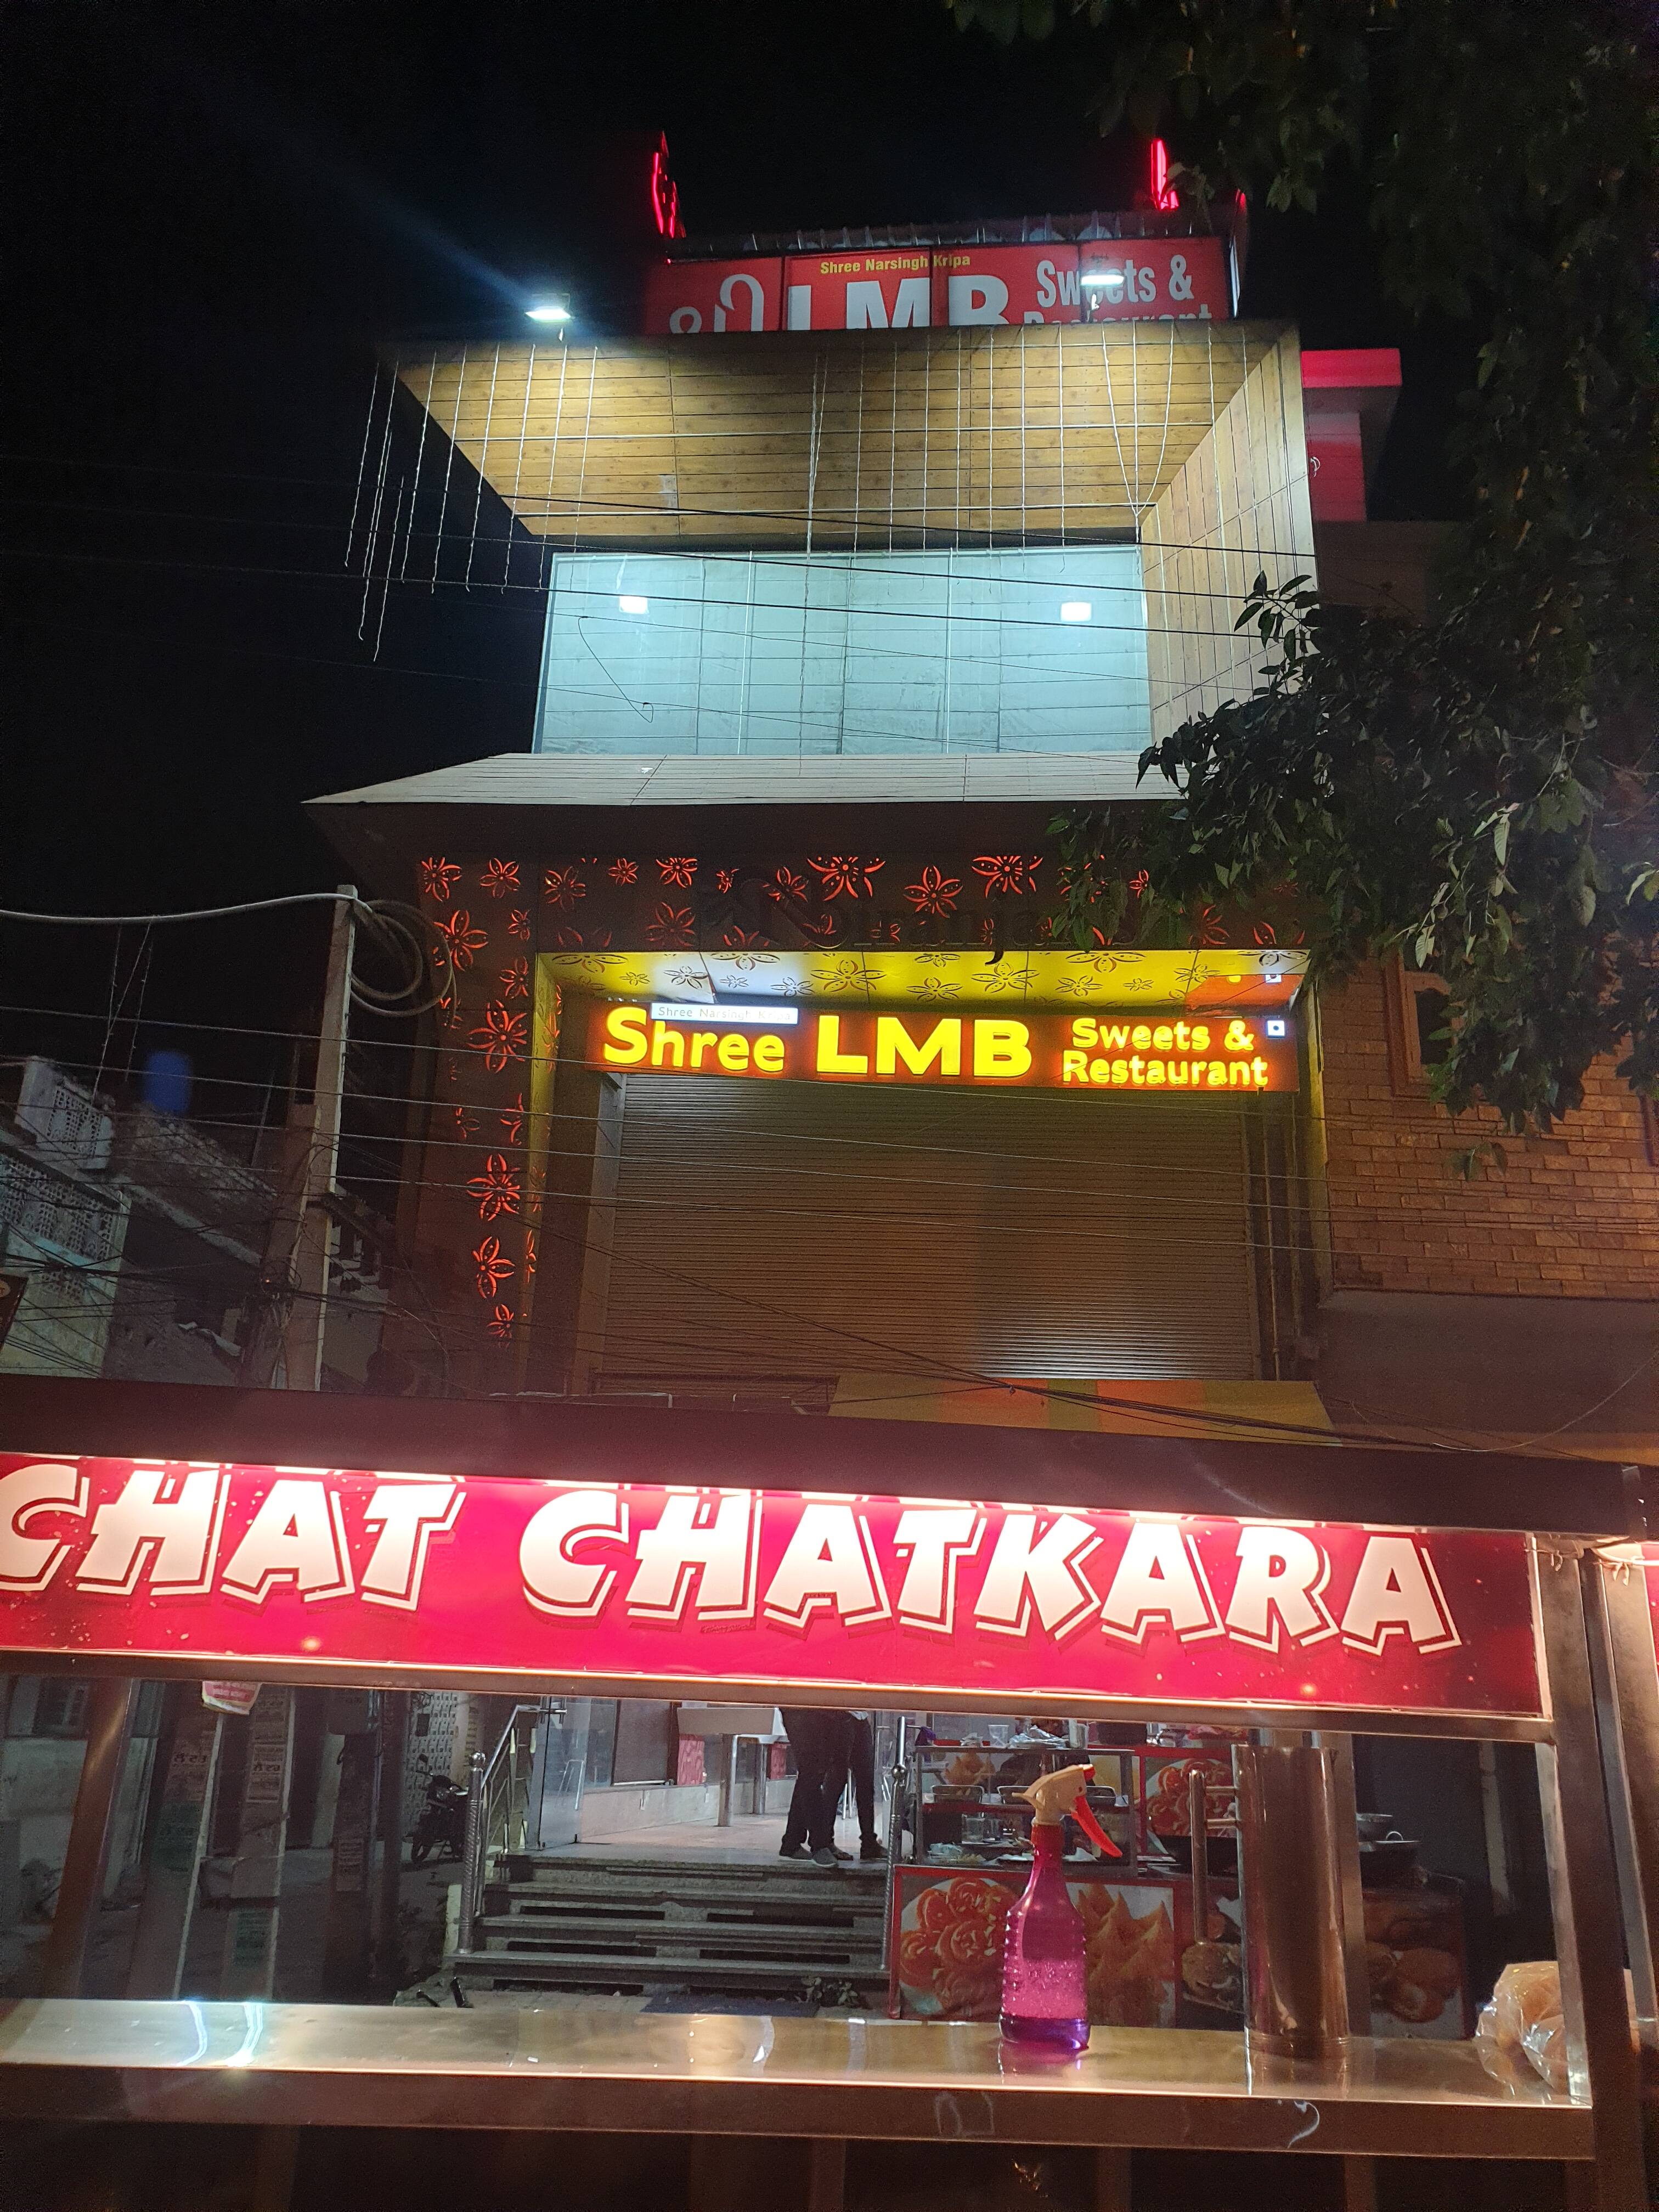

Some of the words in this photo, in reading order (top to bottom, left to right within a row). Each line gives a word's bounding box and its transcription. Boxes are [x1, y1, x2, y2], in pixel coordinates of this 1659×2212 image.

[820, 261, 861, 274] Shree
[865, 256, 928, 271] Narsingh
[933, 255, 970, 268] Kripa
[1036, 259, 1156, 308] Sweets
[1169, 254, 1194, 301] &
[658, 1006, 693, 1018] Shree
[699, 1008, 751, 1021] Narsingh
[604, 1006, 785, 1073] Shree
[816, 1014, 1032, 1077] LMB
[1072, 1018, 1210, 1051] Sweets
[1223, 1019, 1254, 1051] &
[1063, 1049, 1268, 1086] Restaurant
[0, 1463, 466, 1612] CHAT
[518, 1489, 1462, 1654] CHATKARA
